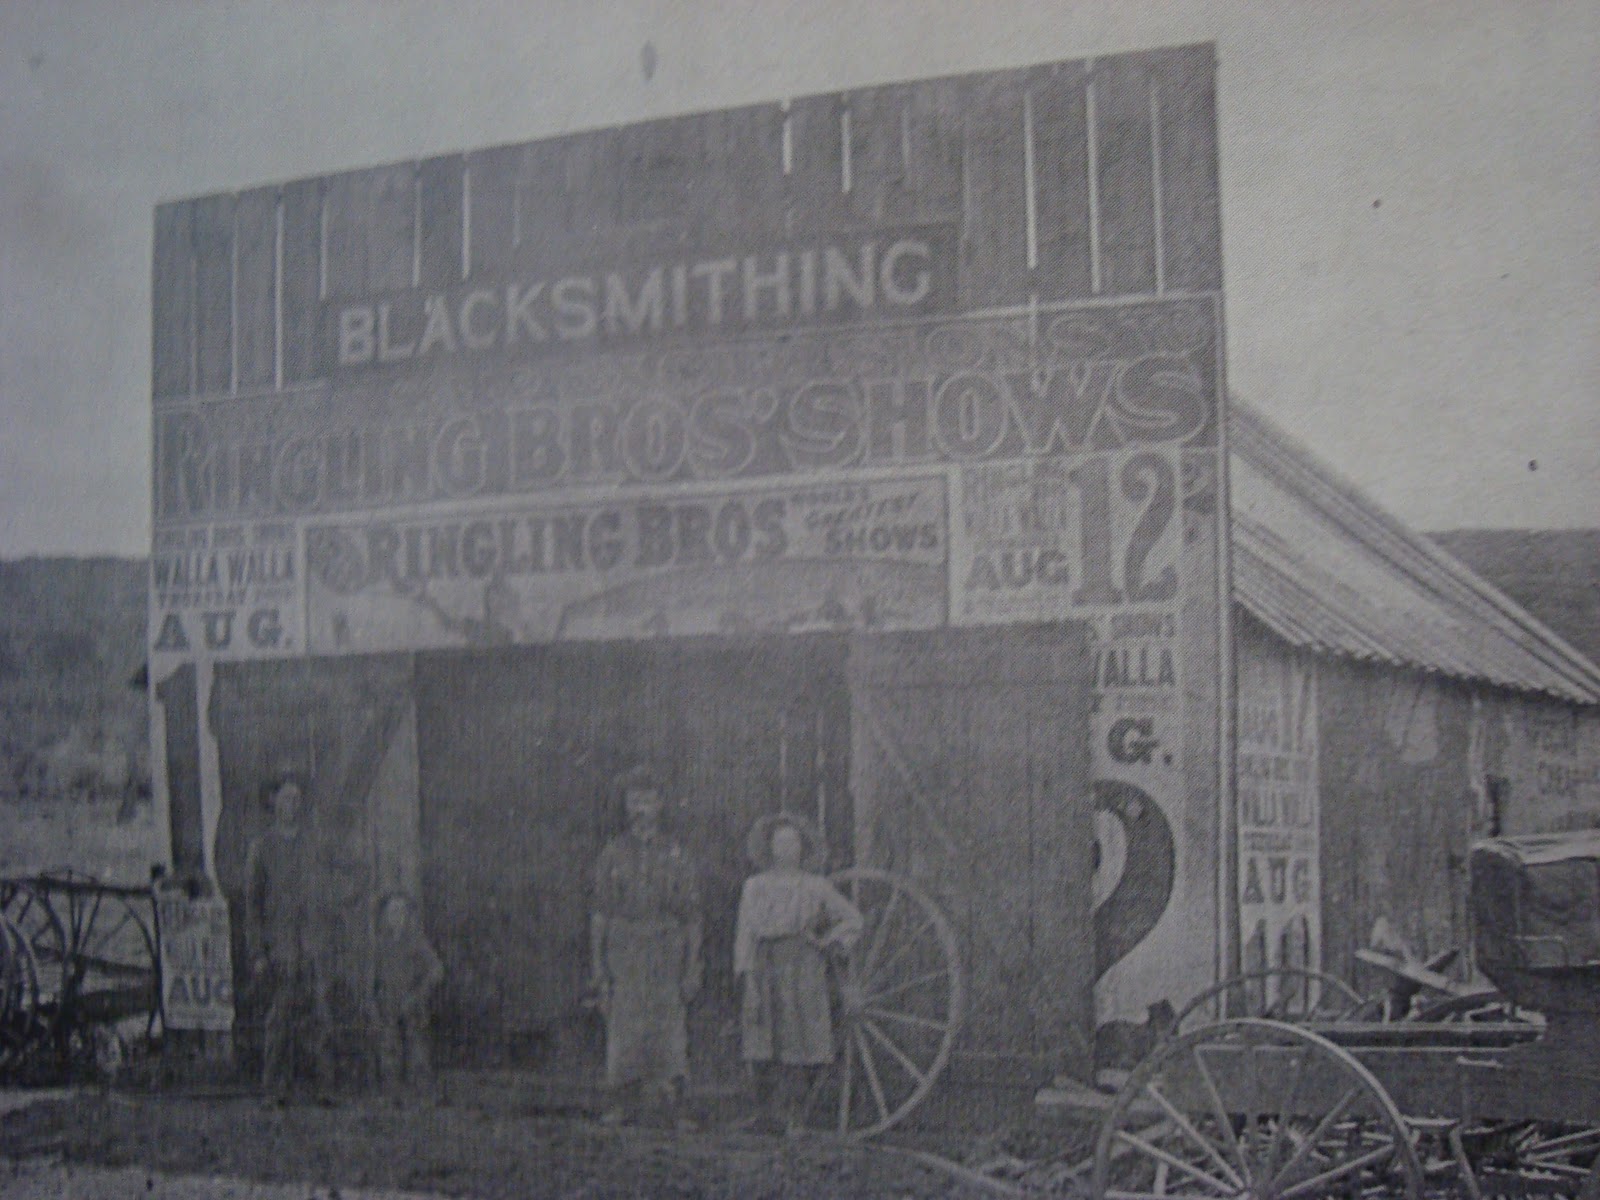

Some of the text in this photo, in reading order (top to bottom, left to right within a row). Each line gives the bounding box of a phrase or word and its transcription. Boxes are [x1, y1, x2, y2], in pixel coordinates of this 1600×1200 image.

[336, 239, 934, 366] BLACKSMITHING
[786, 352, 1209, 470] SHOWS
[825, 521, 939, 555] SHOWS
[1069, 454, 1178, 605] 12
